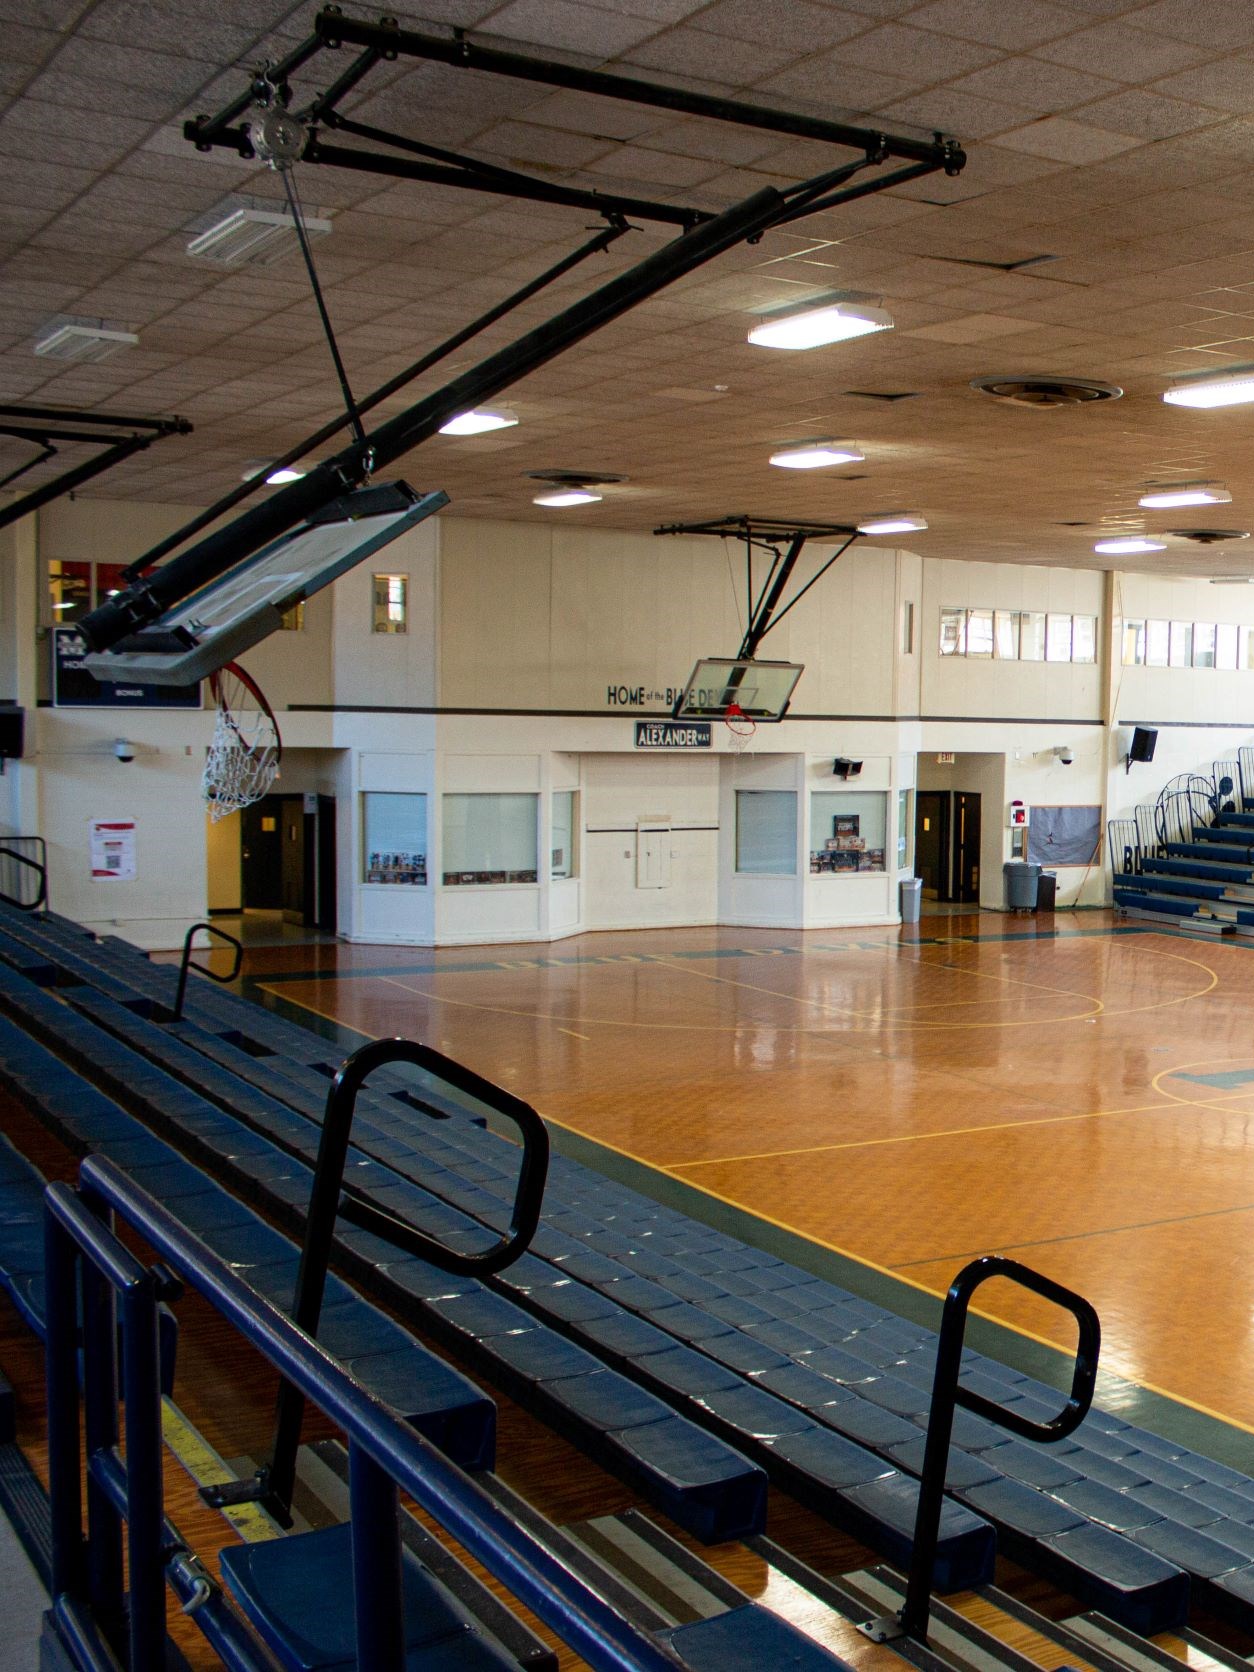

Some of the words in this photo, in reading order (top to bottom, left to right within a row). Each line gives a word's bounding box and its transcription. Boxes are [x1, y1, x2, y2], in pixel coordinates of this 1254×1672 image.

[607, 686, 645, 705] HOME
[646, 691, 653, 700] of
[654, 691, 664, 700] the
[638, 729, 698, 745] ALEXANDER
[698, 733, 710, 741] WAY
